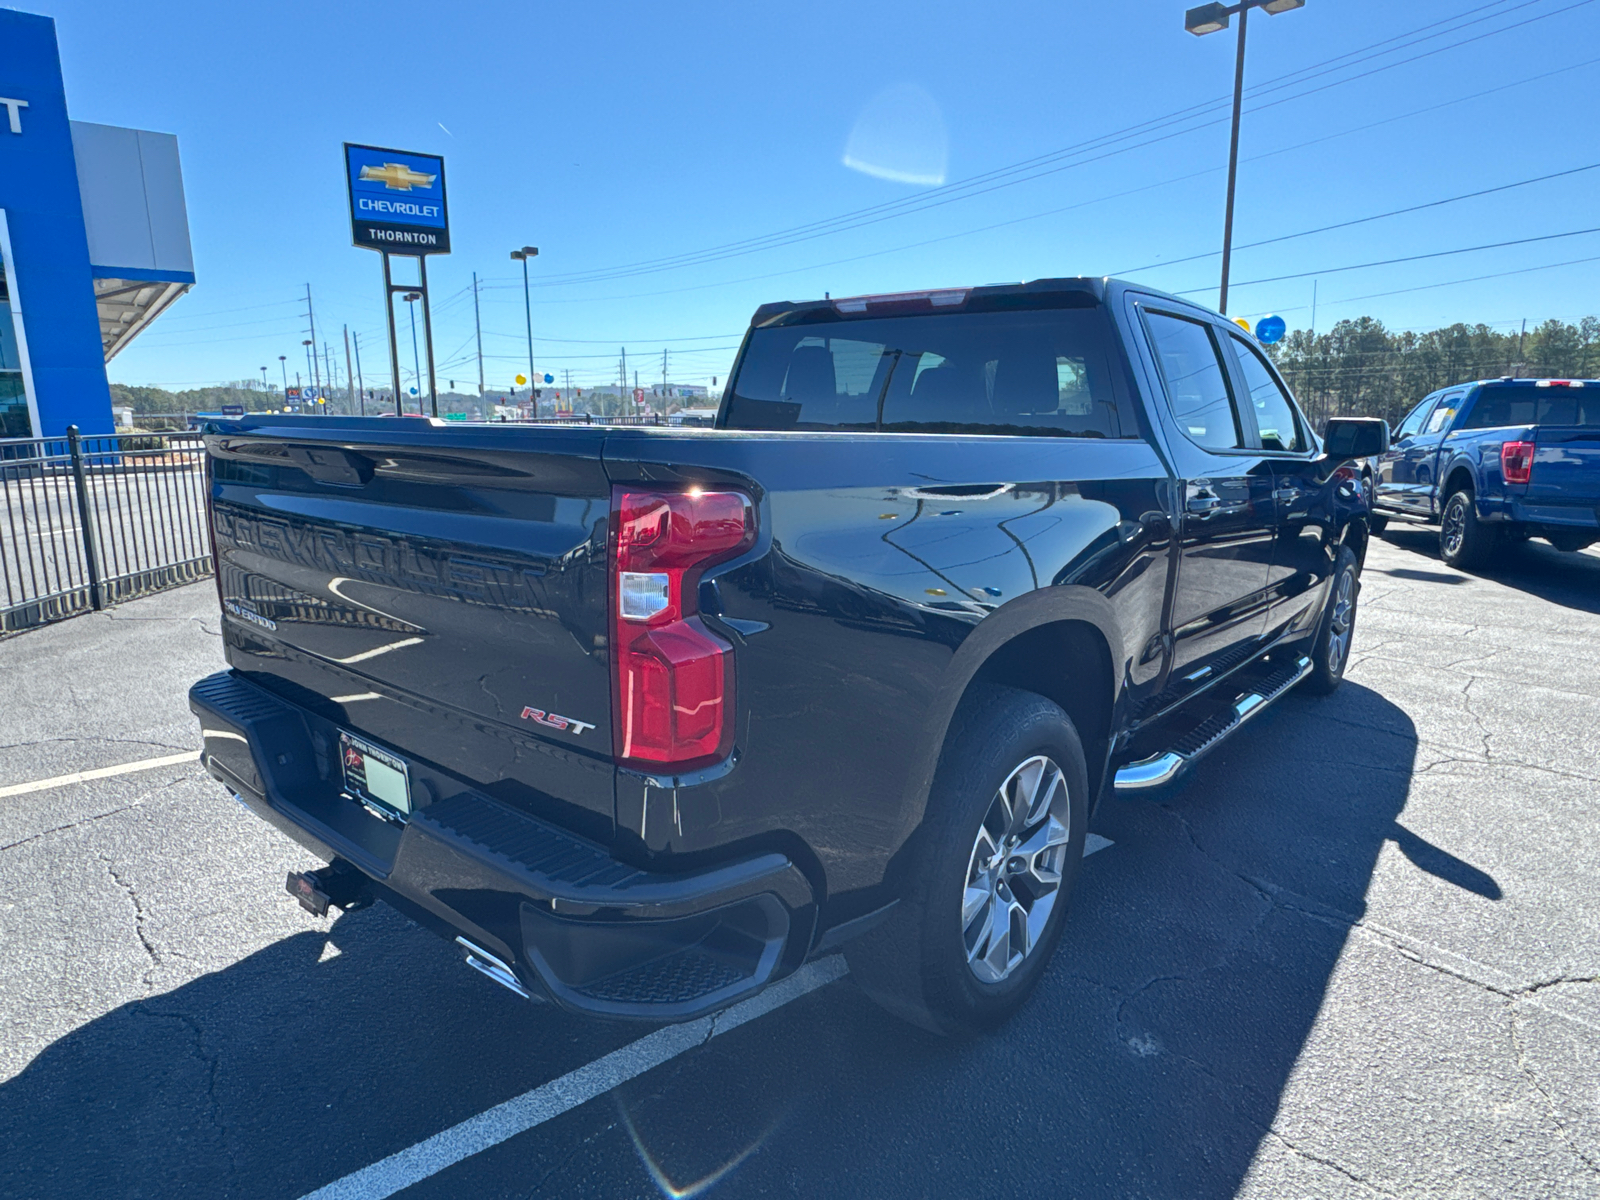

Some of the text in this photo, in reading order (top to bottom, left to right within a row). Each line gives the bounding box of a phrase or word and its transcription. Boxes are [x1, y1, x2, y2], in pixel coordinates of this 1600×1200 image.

[359, 199, 439, 217] CHEVROLET
[369, 229, 436, 244] THORNTON
[214, 503, 547, 603] CHEVROLET
[225, 601, 277, 631] SILVERADO
[521, 706, 596, 735] RST
